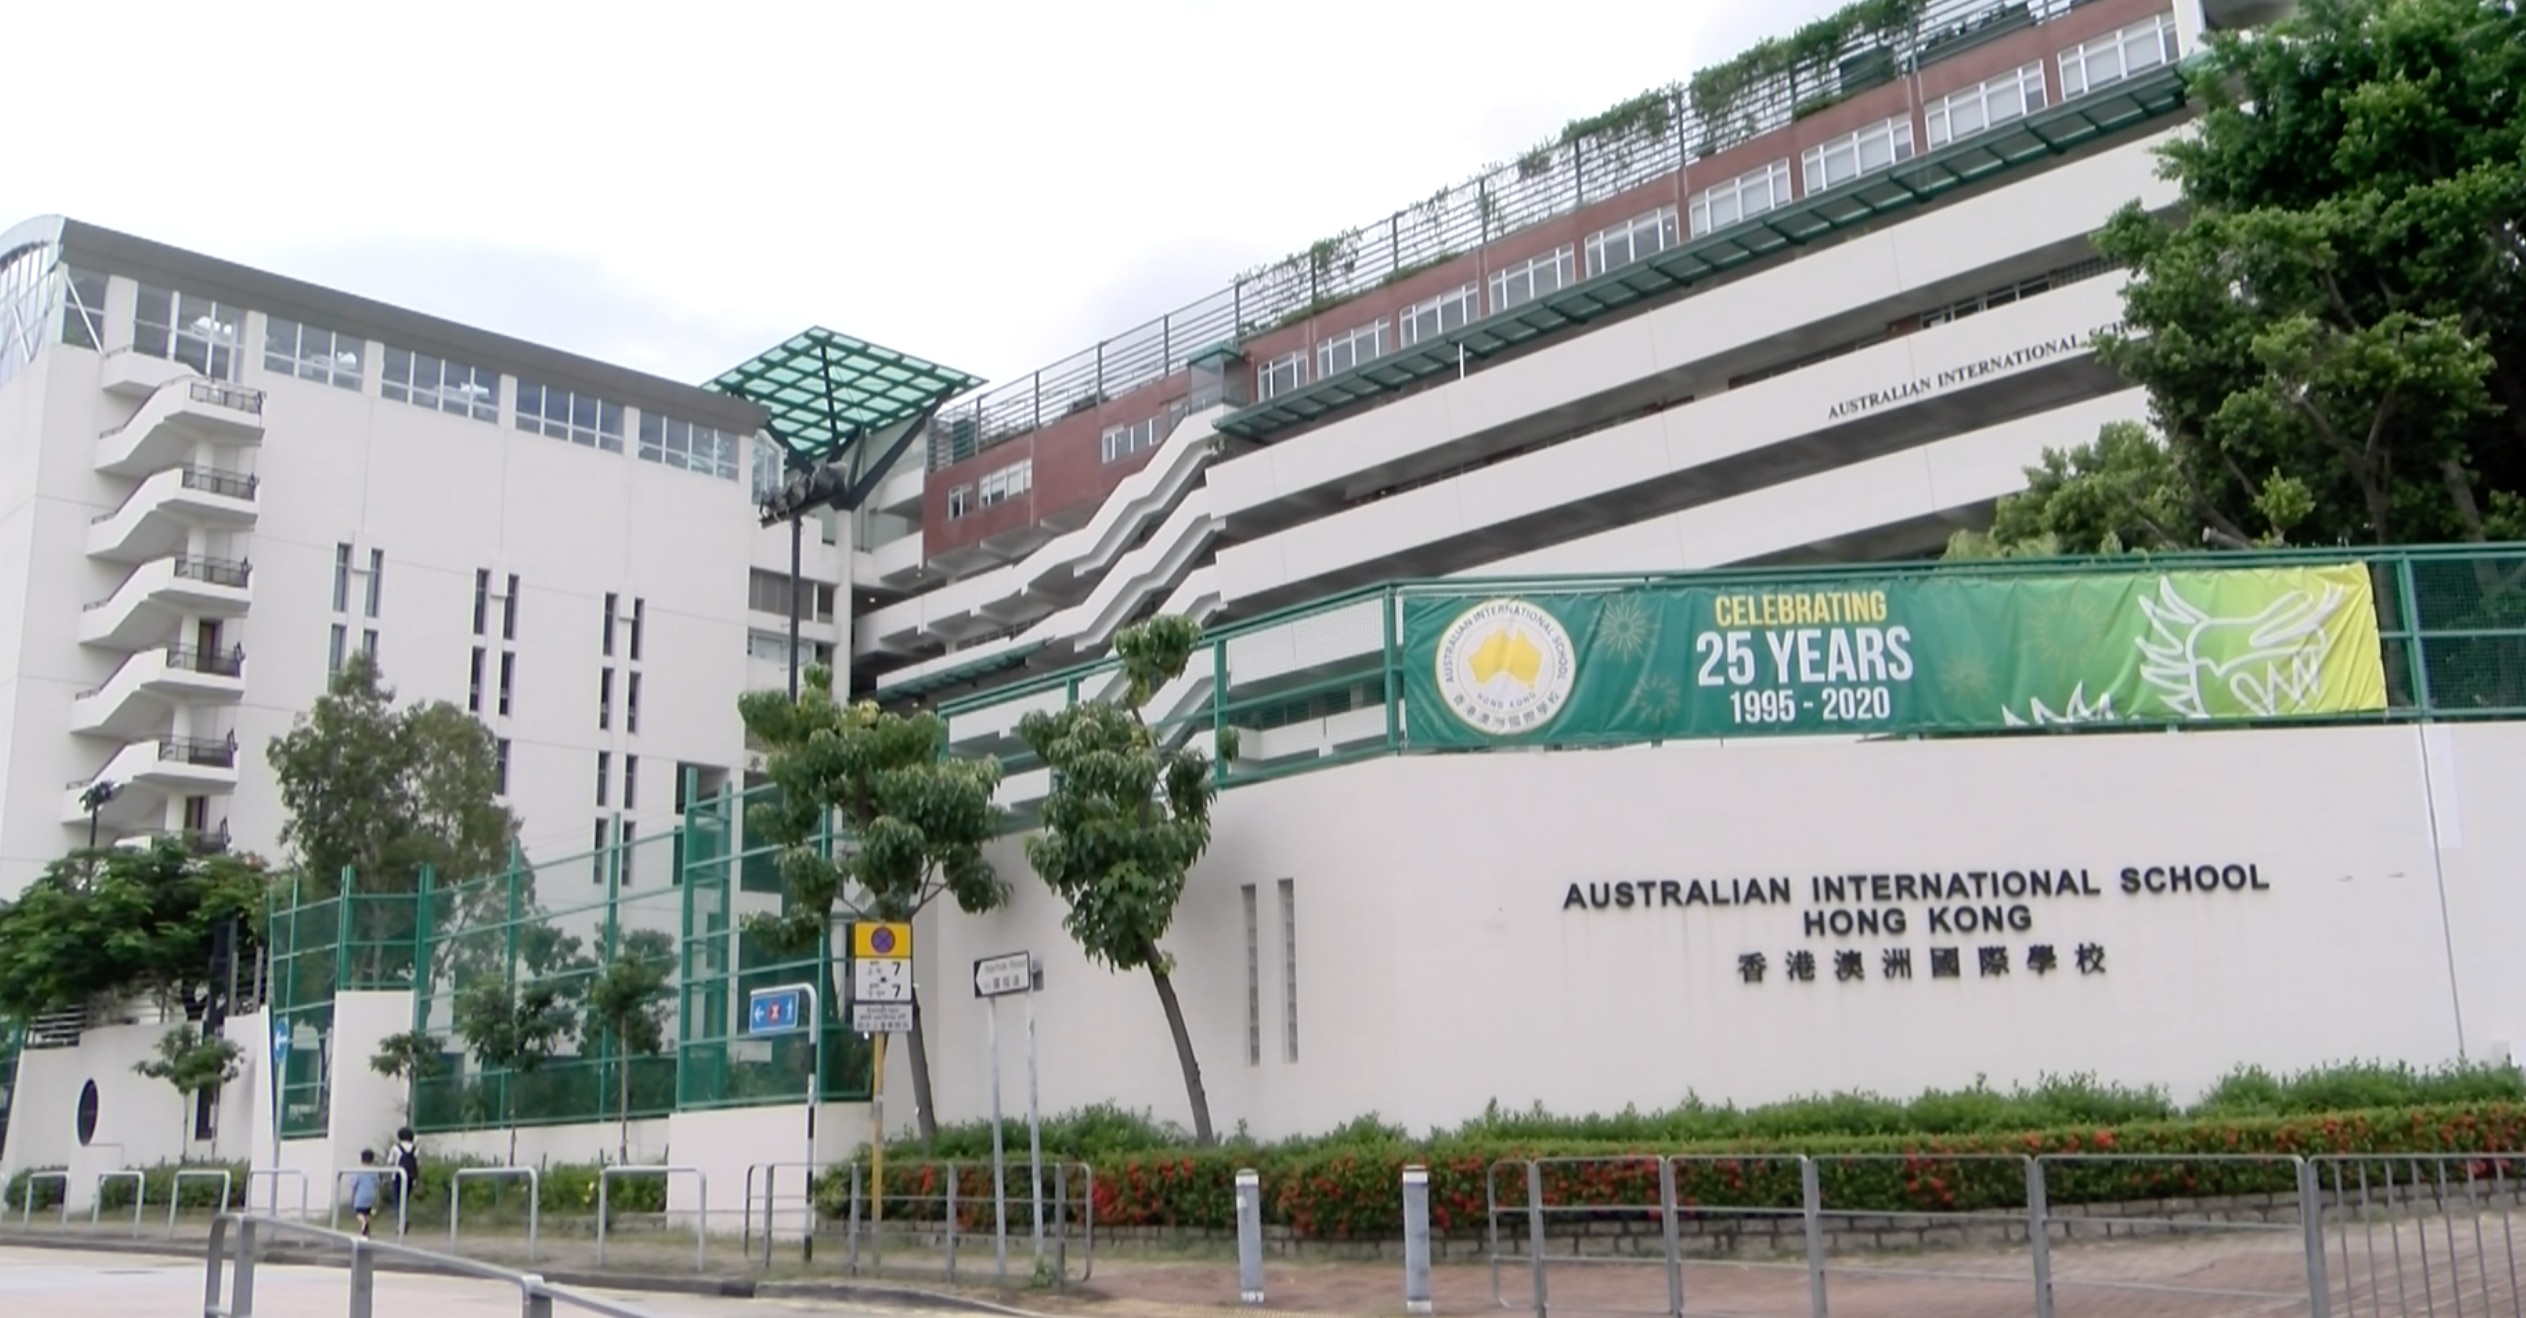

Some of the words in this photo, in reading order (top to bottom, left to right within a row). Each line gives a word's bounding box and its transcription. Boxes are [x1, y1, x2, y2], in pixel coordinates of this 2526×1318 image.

[1827, 376, 1932, 420] AUSTRALIAN
[1937, 333, 2080, 388] INTERNATIONAL
[1715, 590, 1888, 628] CELEBRATING
[1443, 618, 1474, 684] AUSTRALIAN
[1473, 603, 1554, 635] INTERNATIONAL
[1551, 635, 1569, 681] SCHOOL
[1696, 630, 1756, 687] 25
[1765, 625, 1914, 684] YEARS
[1477, 691, 1505, 709] HONG
[1509, 691, 1537, 708] KONG
[1730, 689, 1796, 724] 1995
[1821, 686, 1891, 721] 2020
[1563, 876, 1792, 910] AUSTRALIAN
[1811, 868, 2101, 903] INTERNATIONAL
[2119, 863, 2271, 894] SCHOOL
[1803, 908, 1907, 937] HONG
[1928, 904, 2032, 934] KONG
[892, 961, 902, 976] 7
[1737, 942, 2106, 984] 香港澳洲國際學校
[892, 983, 902, 998] 7
